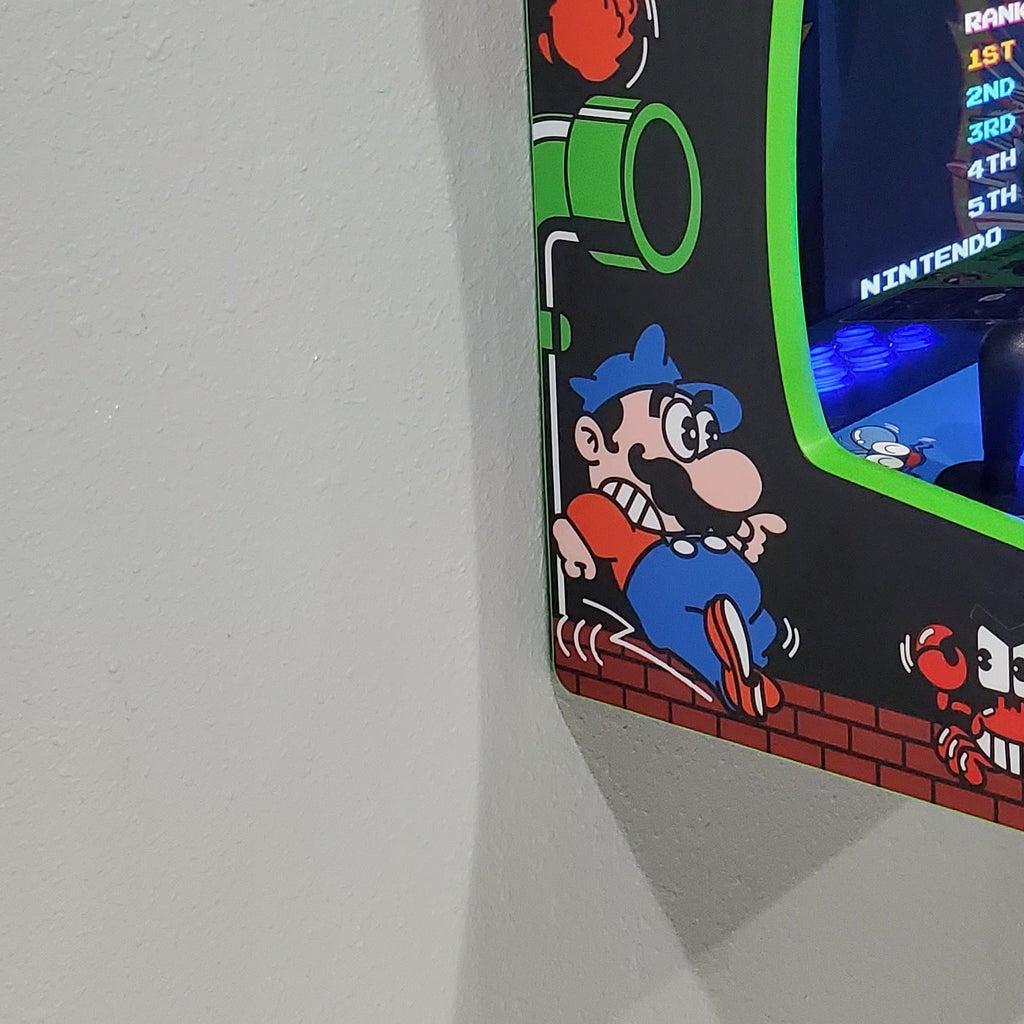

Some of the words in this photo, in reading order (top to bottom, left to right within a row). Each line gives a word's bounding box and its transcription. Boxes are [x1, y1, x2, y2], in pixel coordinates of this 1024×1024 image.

[968, 40, 1016, 71] 1ST
[966, 77, 1016, 108] 2ND
[967, 113, 1016, 145] 3RD
[967, 149, 1017, 180] 4TH
[968, 184, 1017, 218] 5TH
[860, 226, 1002, 301] NINTENDO
